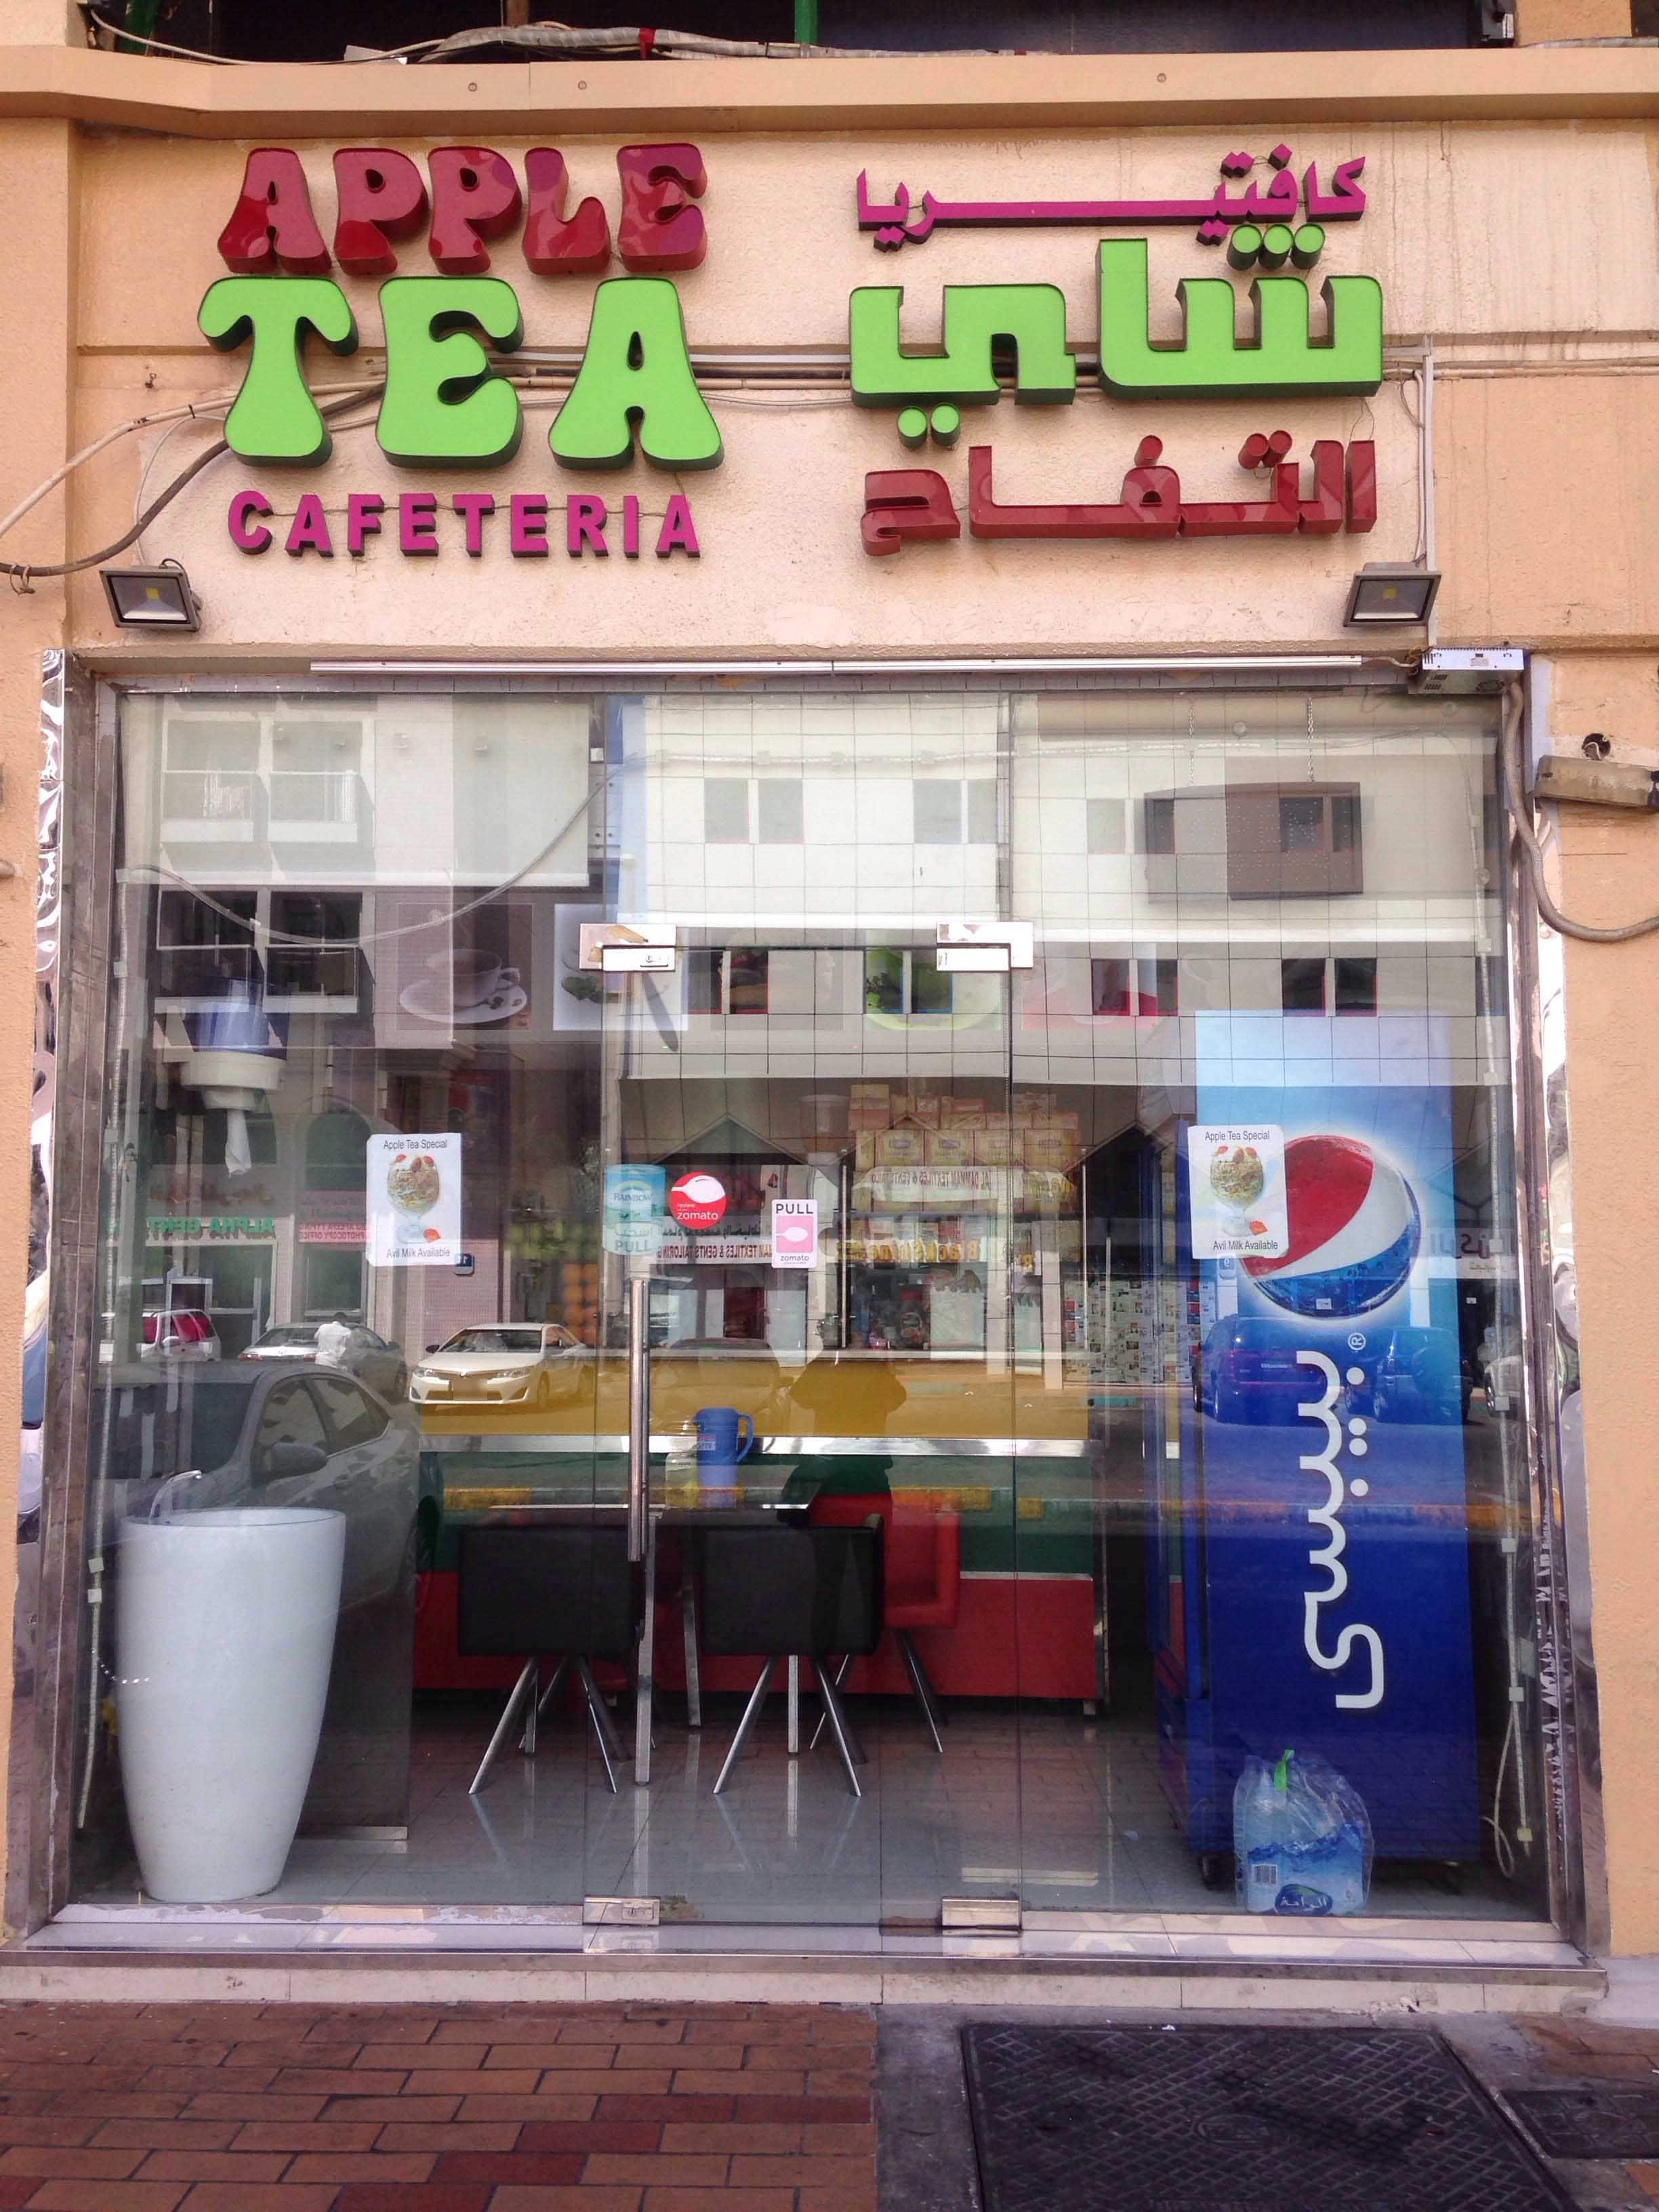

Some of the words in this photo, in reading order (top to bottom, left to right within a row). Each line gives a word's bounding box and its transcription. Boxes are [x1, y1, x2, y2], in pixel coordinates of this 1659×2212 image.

[856, 143, 1366, 252] كافيتريا
[217, 143, 708, 274] APPLE
[849, 223, 1383, 449] شاي
[197, 275, 725, 470] TEA
[861, 430, 1377, 556] التفاح
[227, 489, 701, 558] CAFETERIA
[1205, 1131, 1225, 1143] Apple
[1227, 1130, 1241, 1141] Tea
[1243, 1130, 1270, 1142] Special
[384, 1139, 404, 1150] Apple
[406, 1139, 419, 1149] Tea
[421, 1139, 448, 1150] Special
[614, 1192, 652, 1202] RAINBOW
[775, 1203, 813, 1214] PULL
[677, 1211, 718, 1221] zomato
[1213, 1240, 1227, 1250] Avil
[1229, 1240, 1243, 1250] Milk
[1245, 1240, 1278, 1250] Available
[402, 1248, 417, 1258] Milk
[417, 1247, 450, 1258] Available
